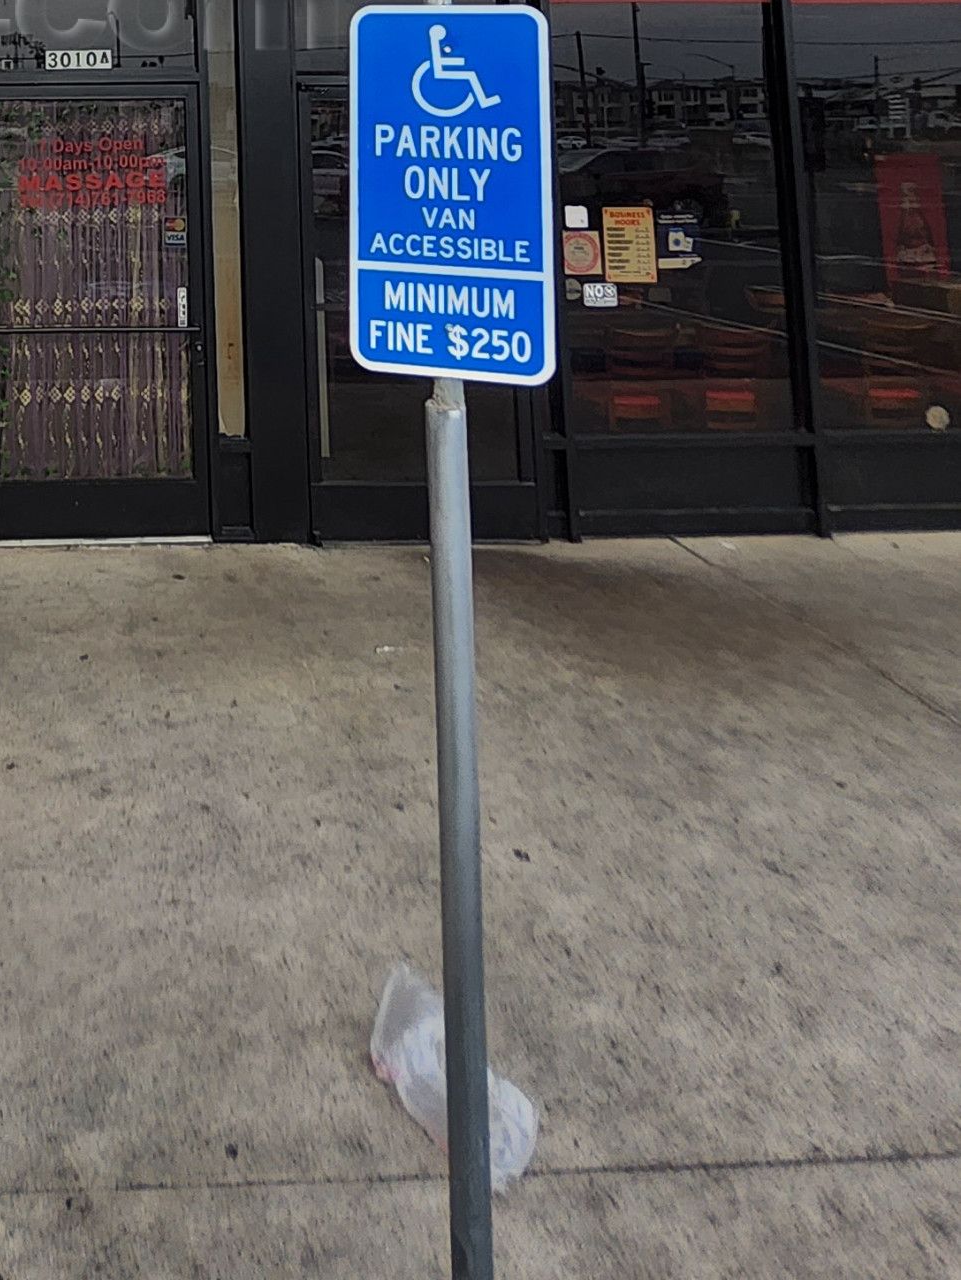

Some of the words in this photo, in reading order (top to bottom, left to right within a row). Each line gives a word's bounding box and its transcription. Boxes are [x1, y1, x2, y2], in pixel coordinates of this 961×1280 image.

[47, 51, 110, 69] 3010A
[53, 138, 92, 155] Days
[99, 137, 144, 154] Open
[375, 124, 523, 161] PARKING
[18, 171, 167, 192] MASSAGE
[404, 165, 491, 201] ONLY
[422, 207, 475, 230] VAN
[370, 233, 530, 263] ACCESSIBLE
[384, 281, 515, 319] MINIMUM
[370, 320, 433, 354] FINE
[447, 324, 532, 363] $250
